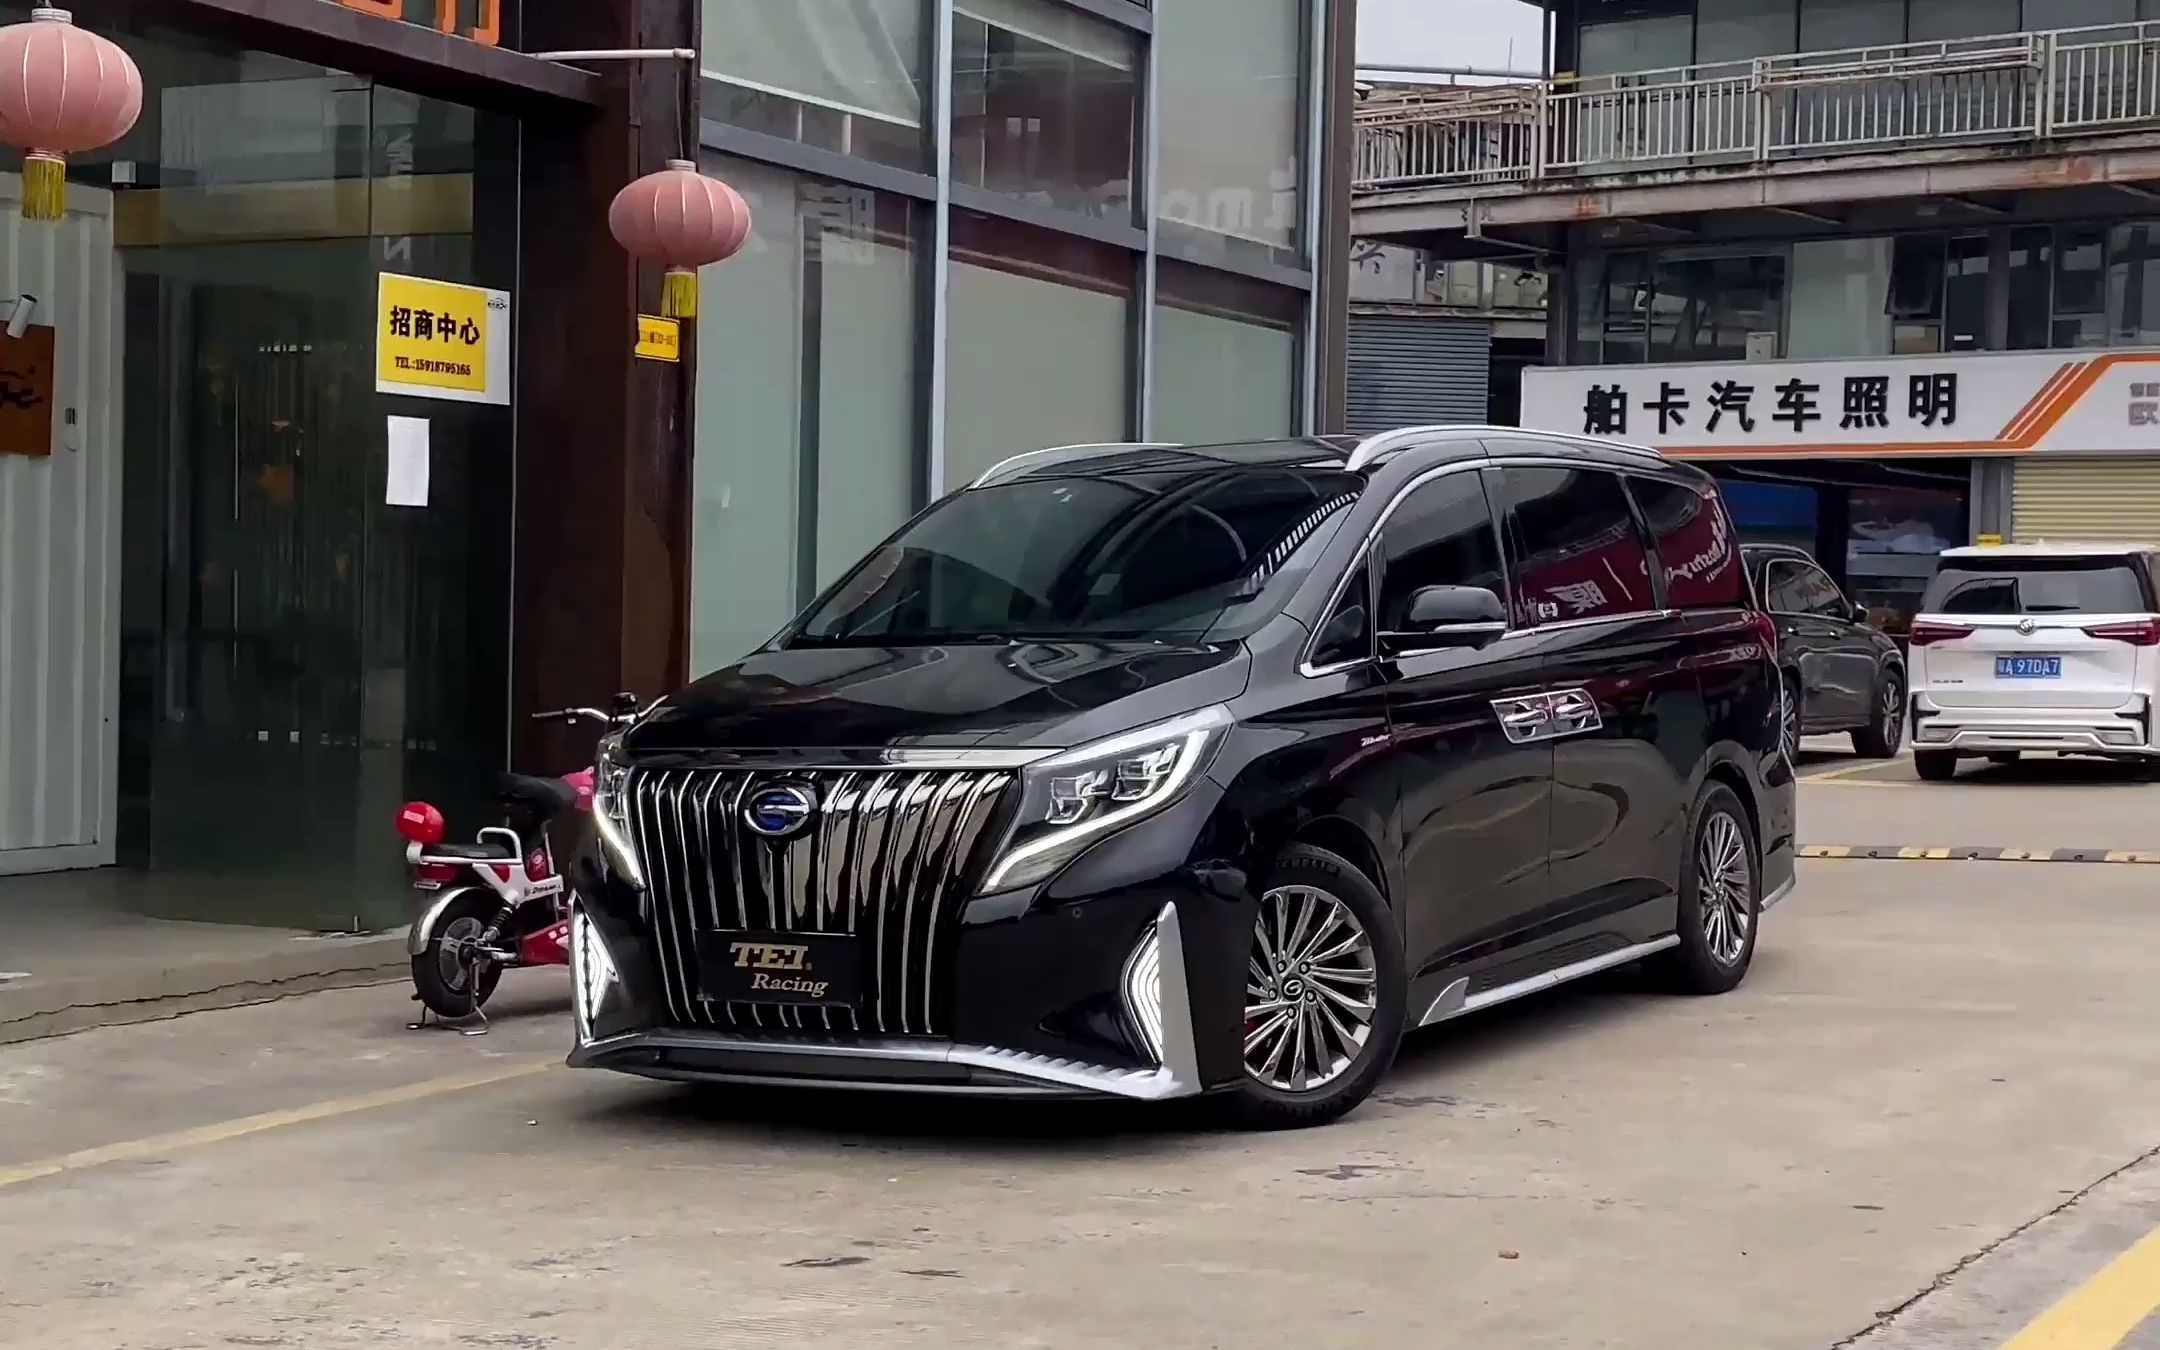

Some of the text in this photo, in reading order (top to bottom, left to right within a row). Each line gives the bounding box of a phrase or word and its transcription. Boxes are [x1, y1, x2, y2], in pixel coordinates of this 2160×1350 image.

[389, 305, 480, 345] 招商中心
[1583, 373, 1958, 435] 舶卡汽车照明
[751, 973, 829, 998] Racing
